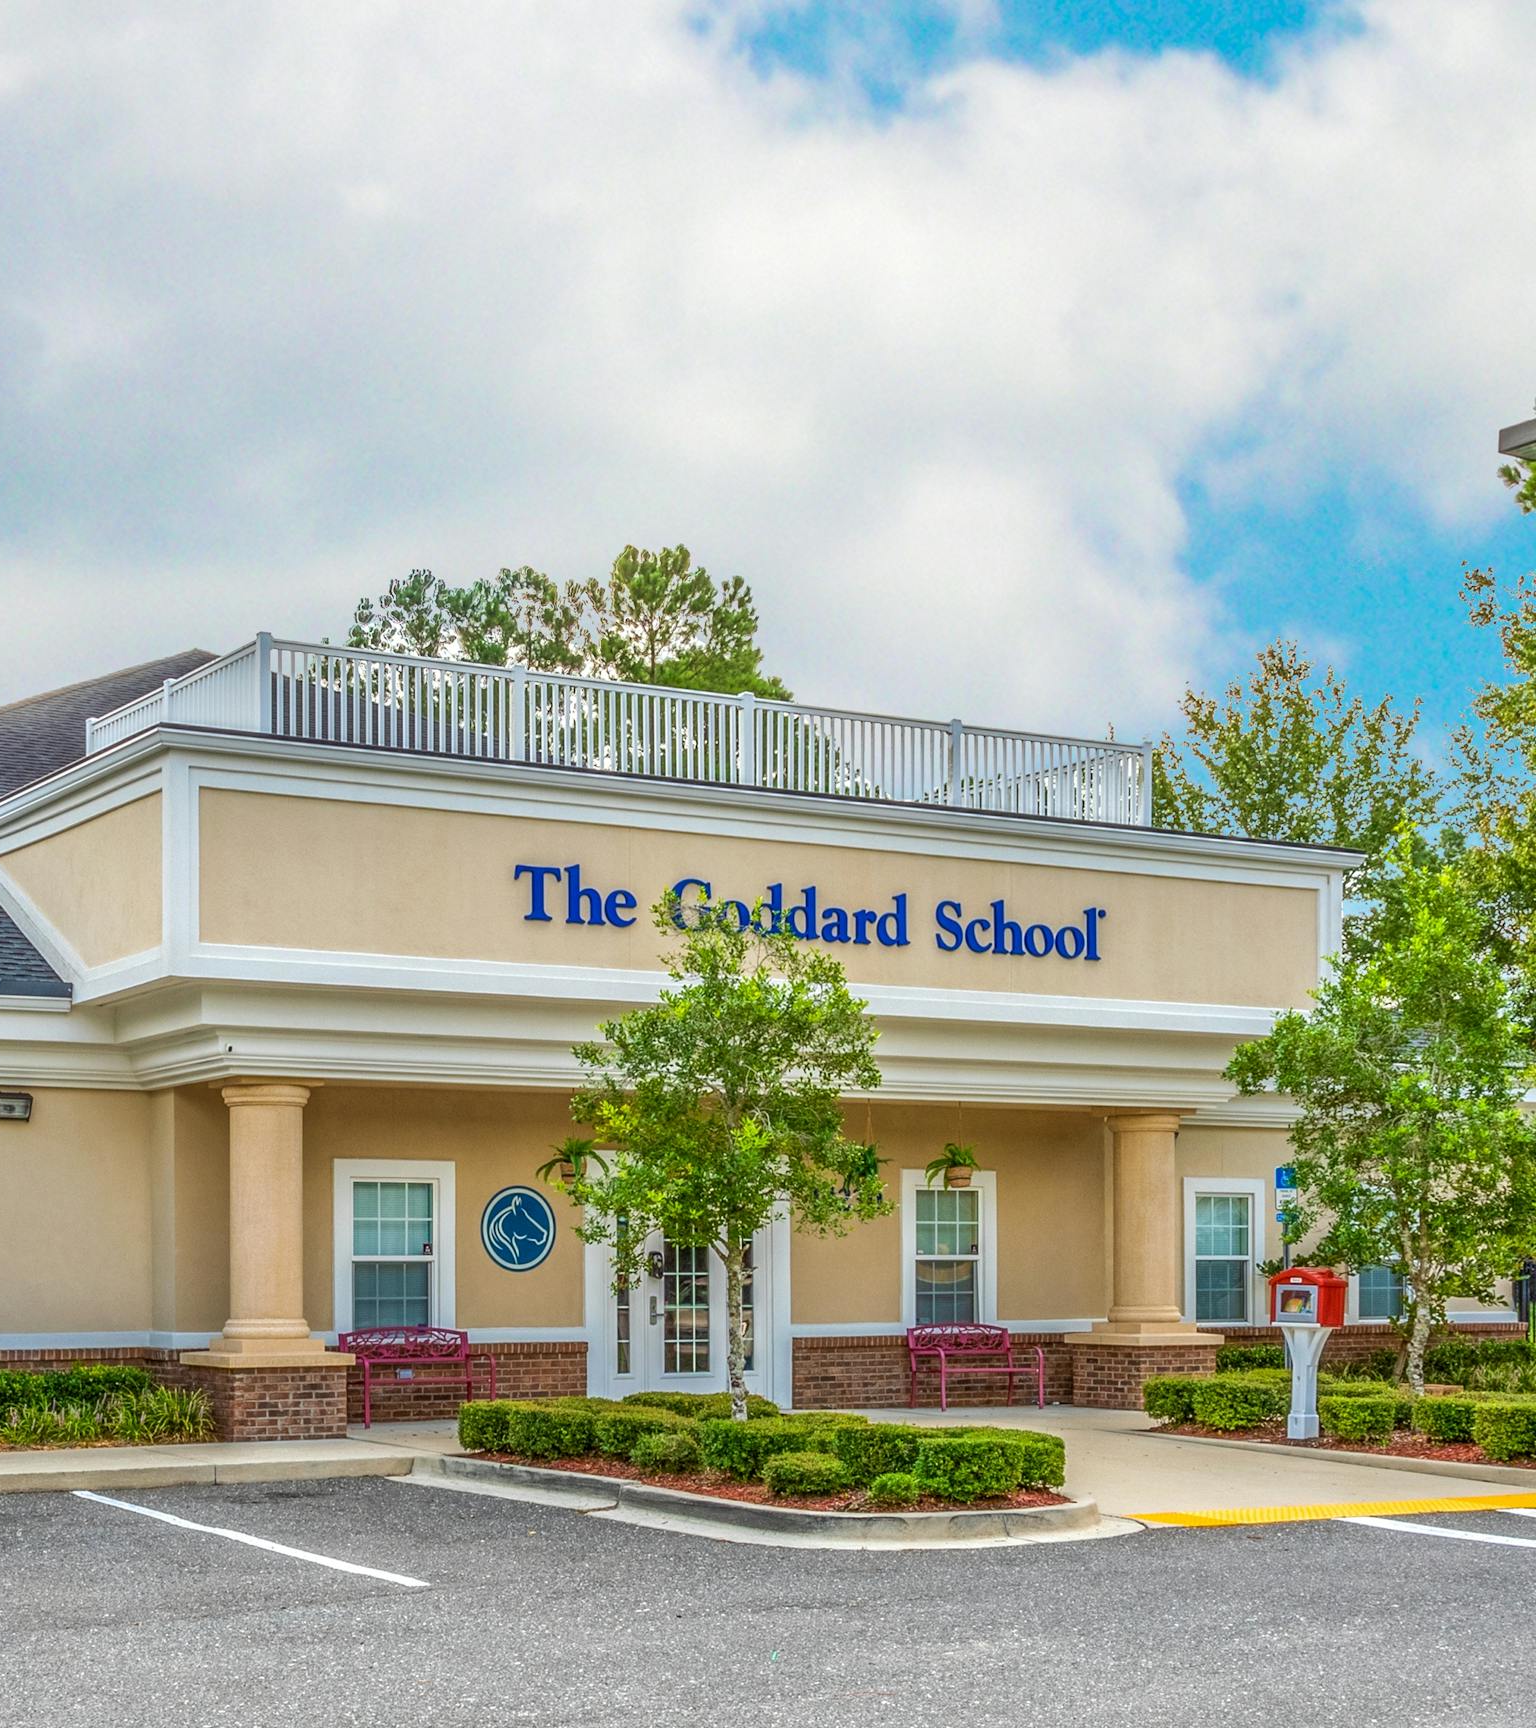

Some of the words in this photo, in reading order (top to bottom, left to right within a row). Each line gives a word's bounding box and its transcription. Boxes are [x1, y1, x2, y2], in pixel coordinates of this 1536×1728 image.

[514, 863, 638, 928] The
[670, 877, 910, 947] Goddard
[935, 899, 1101, 961] School
